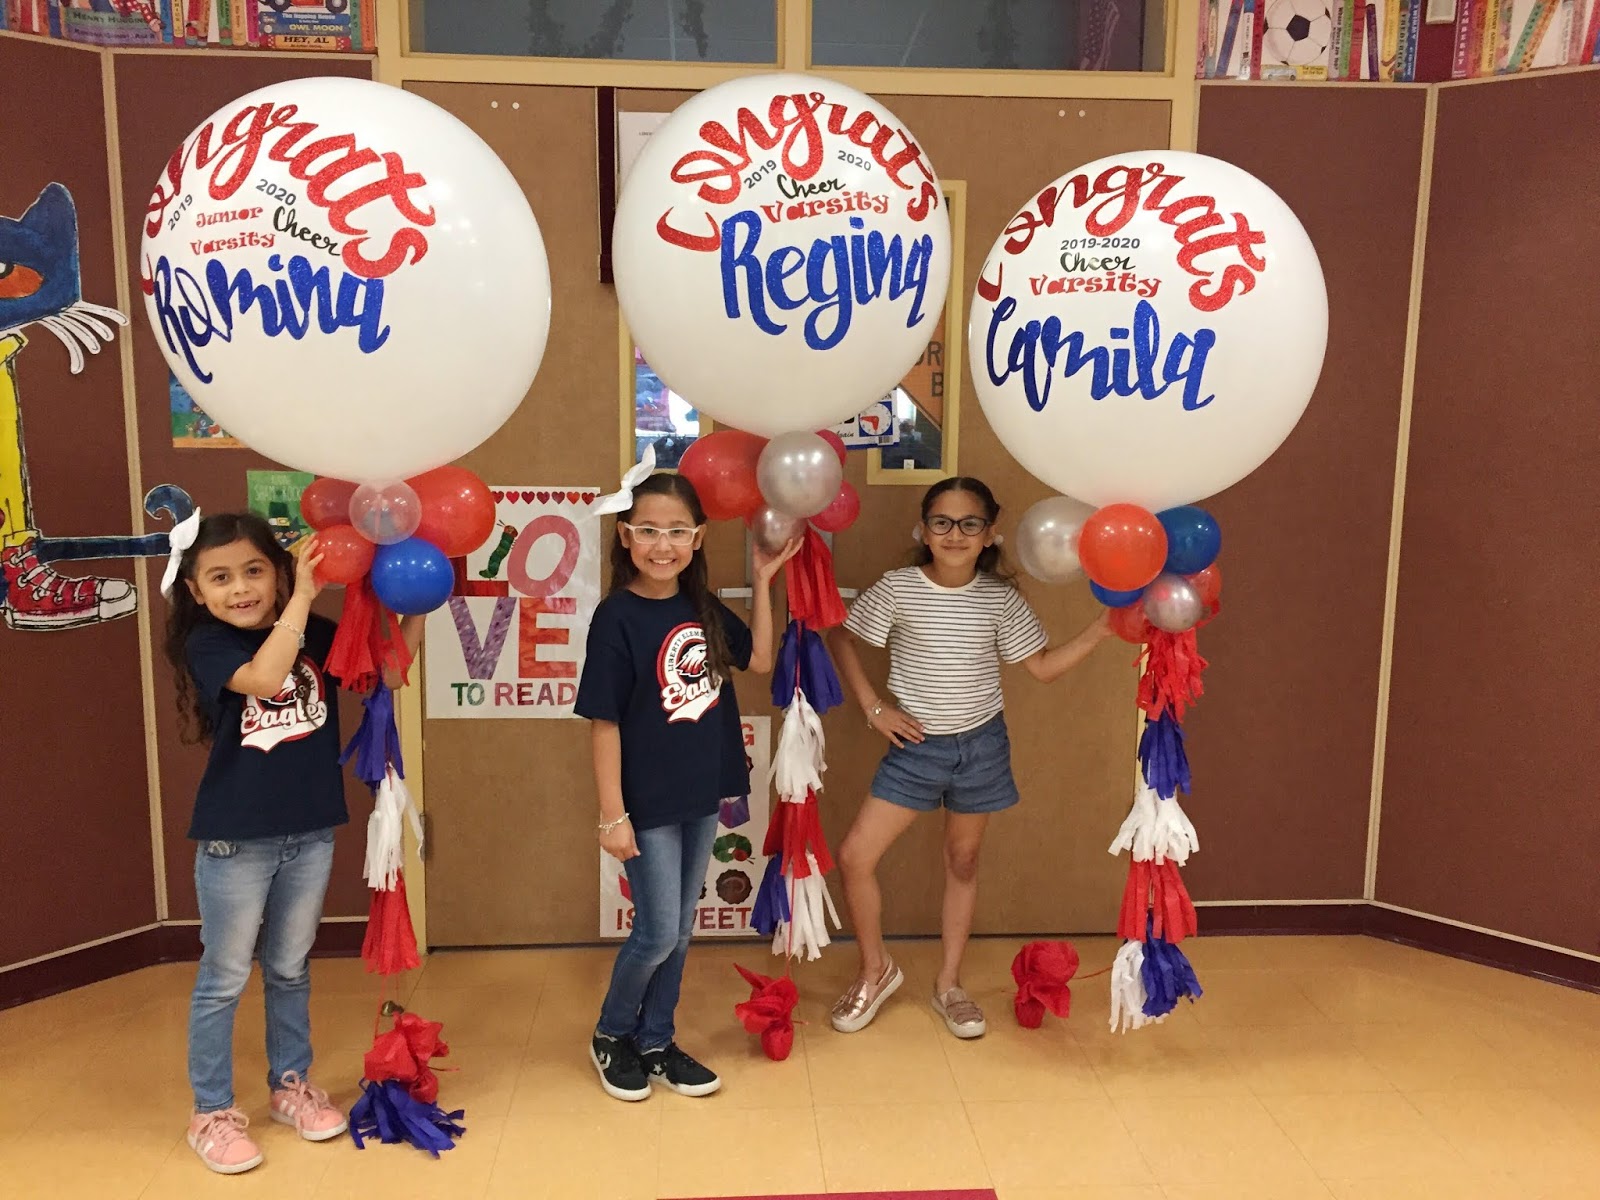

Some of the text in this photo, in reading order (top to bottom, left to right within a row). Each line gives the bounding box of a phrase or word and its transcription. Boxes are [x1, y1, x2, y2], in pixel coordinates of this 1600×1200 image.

[108, 14, 147, 24] HUGGIN
[656, 92, 939, 252] Congrats
[837, 150, 872, 171] 2020
[744, 160, 777, 189] 2019
[776, 173, 846, 199] Cheer
[256, 178, 297, 206] 2020
[167, 194, 193, 231] 2019
[195, 206, 263, 228] Junior
[760, 191, 889, 224] Varsity
[190, 231, 276, 256] Varsity
[273, 206, 341, 256] Cheer
[1060, 237, 1141, 251] 2019-2020
[1060, 252, 1136, 273] Cheer
[720, 210, 934, 350] Regina
[1028, 271, 1162, 298] Varsity
[154, 253, 390, 384] Romina
[986, 296, 1216, 412] Camila
[667, 638, 682, 672] LIBERTY
[451, 682, 577, 706] TO READ
[694, 907, 751, 930] EET
